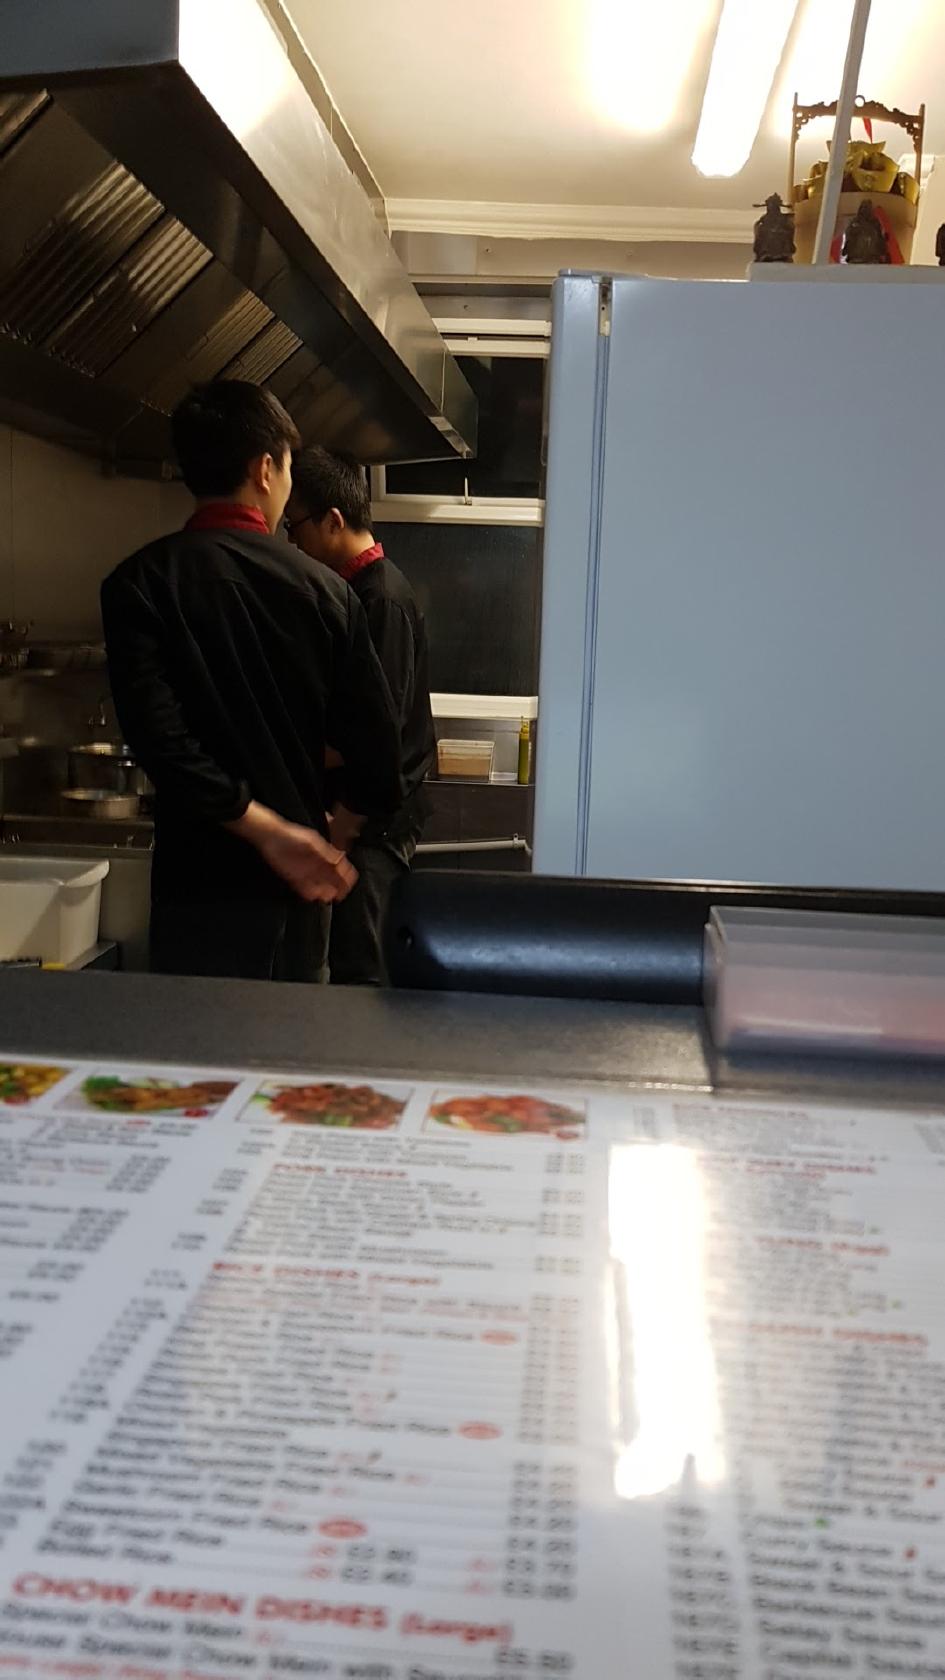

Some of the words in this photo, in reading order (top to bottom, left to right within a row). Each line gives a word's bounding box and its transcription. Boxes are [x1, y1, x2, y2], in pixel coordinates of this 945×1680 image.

[12, 1571, 137, 1604] CHOW
[145, 1587, 246, 1615] MEIN
[255, 1597, 390, 1631] DISHES
